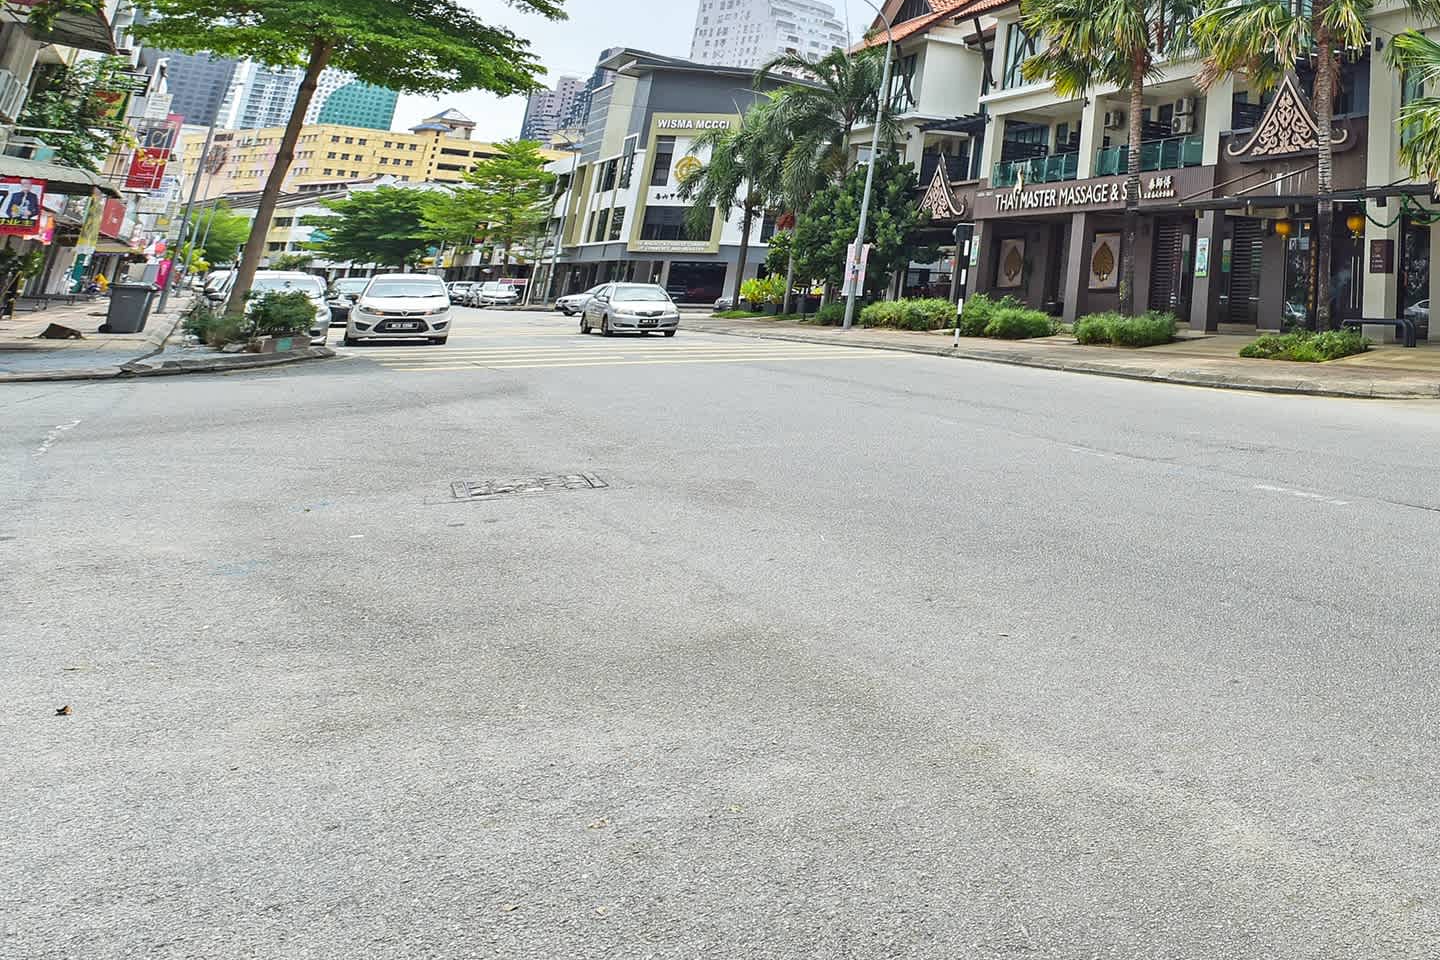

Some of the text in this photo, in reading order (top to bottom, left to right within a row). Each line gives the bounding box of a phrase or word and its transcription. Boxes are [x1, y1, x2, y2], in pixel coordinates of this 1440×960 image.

[657, 119, 730, 130] WISMA MCCCI
[1020, 189, 1057, 210] MASTER
[1058, 183, 1109, 206] MASSAGE
[1110, 183, 1119, 202] &
